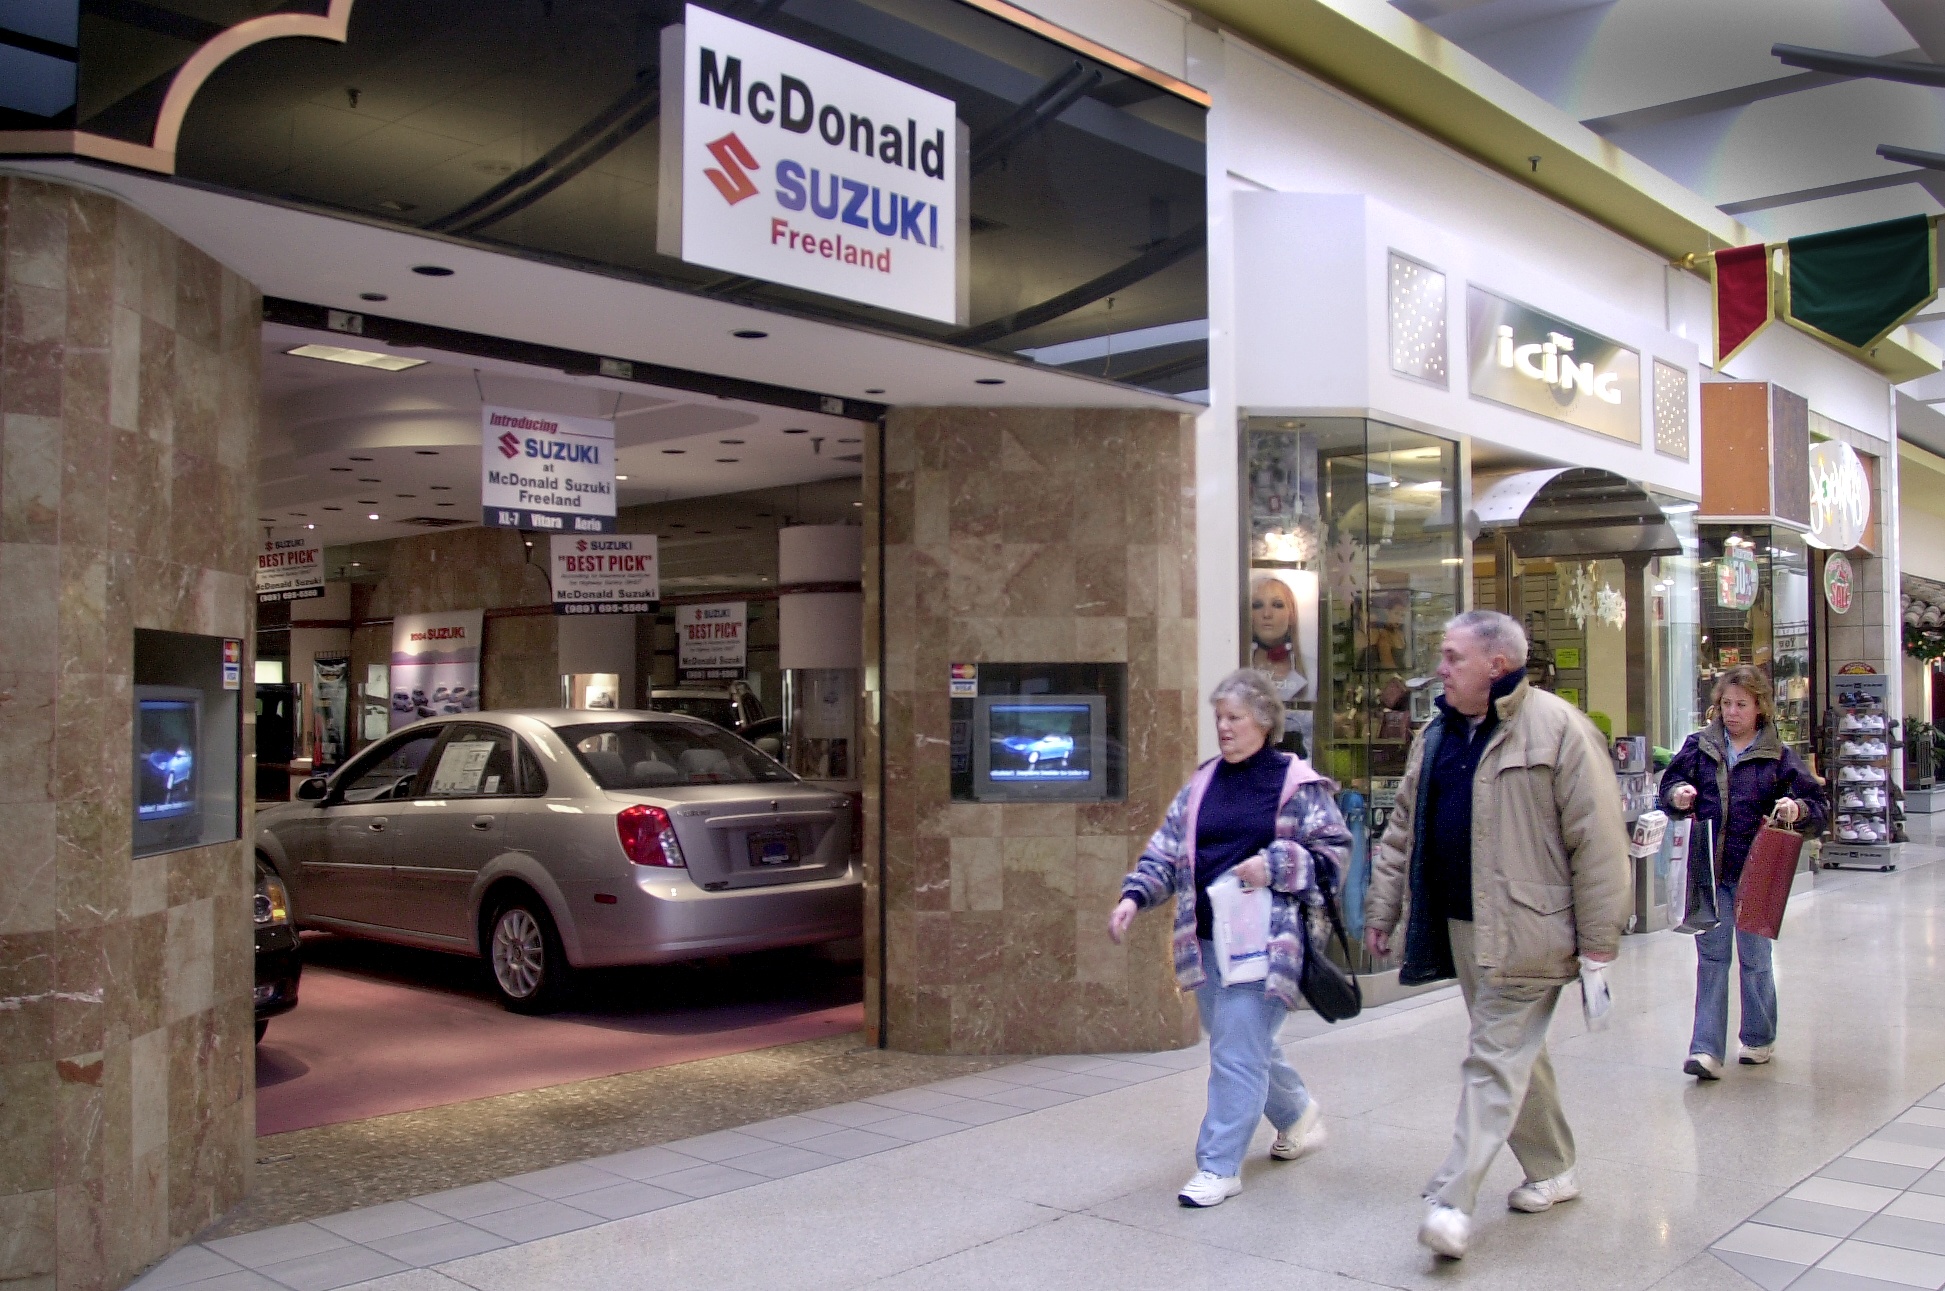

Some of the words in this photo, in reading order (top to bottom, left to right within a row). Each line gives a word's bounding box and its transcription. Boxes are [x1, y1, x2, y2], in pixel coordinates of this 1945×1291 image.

[700, 46, 945, 180] McDonald
[775, 158, 938, 249] SUZUKI
[771, 216, 891, 273] Freeland
[490, 412, 558, 435] Introducing
[525, 438, 599, 464] SUZUKI
[543, 463, 554, 473] at
[489, 470, 558, 490] McDonald
[565, 478, 611, 494] Suzuki
[519, 490, 581, 507] Freeland
[498, 511, 520, 526] XL-7
[531, 513, 563, 529] Vitara
[575, 517, 602, 532] Aerio
[275, 539, 304, 549] SUZUKI
[590, 541, 632, 551] SUZUKI
[558, 555, 604, 571] "BEST
[608, 555, 652, 571] PICK"
[295, 576, 322, 587] Suzuki
[557, 590, 613, 599] McDonald
[618, 589, 655, 598] Suzuki
[704, 608, 731, 619] SUZUKI
[427, 627, 465, 640] SUZUKI
